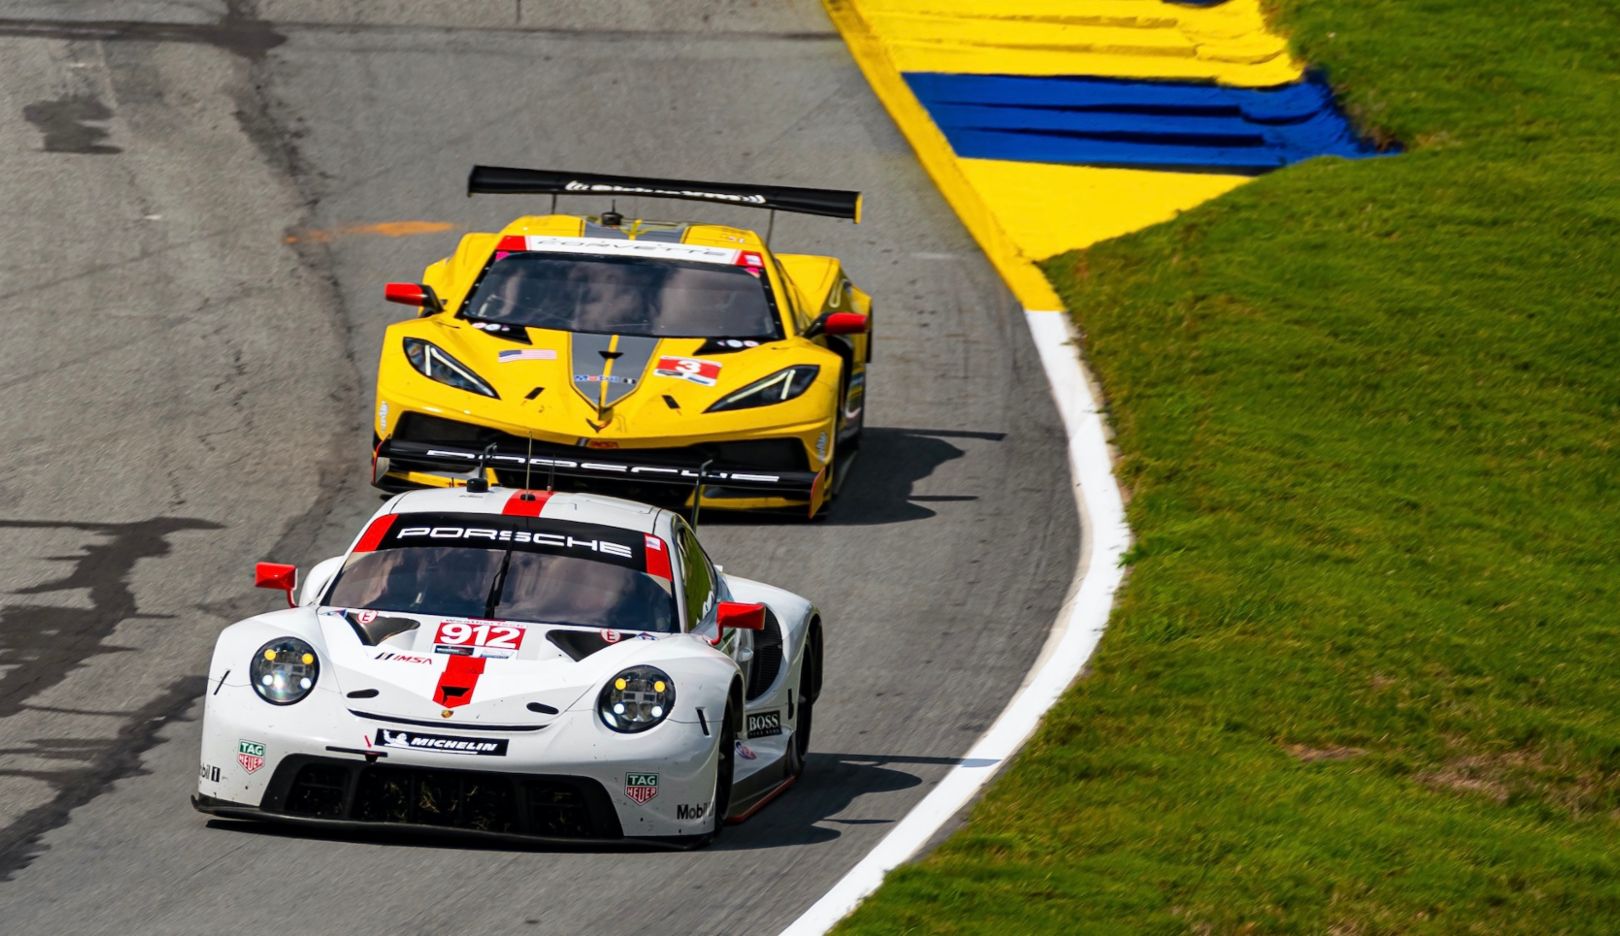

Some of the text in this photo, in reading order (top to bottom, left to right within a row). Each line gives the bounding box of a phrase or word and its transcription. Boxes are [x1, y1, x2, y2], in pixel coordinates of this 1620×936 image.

[674, 359, 701, 374] 3
[397, 527, 632, 558] PORSCHE
[440, 623, 521, 649] 912
[393, 654, 433, 666] IMSA
[748, 713, 779, 732] BOSS
[241, 742, 263, 756] TAG
[410, 737, 498, 752] MICHELIN
[239, 753, 264, 771] HEUER
[629, 775, 656, 786] TAG
[627, 786, 657, 803] HEUER
